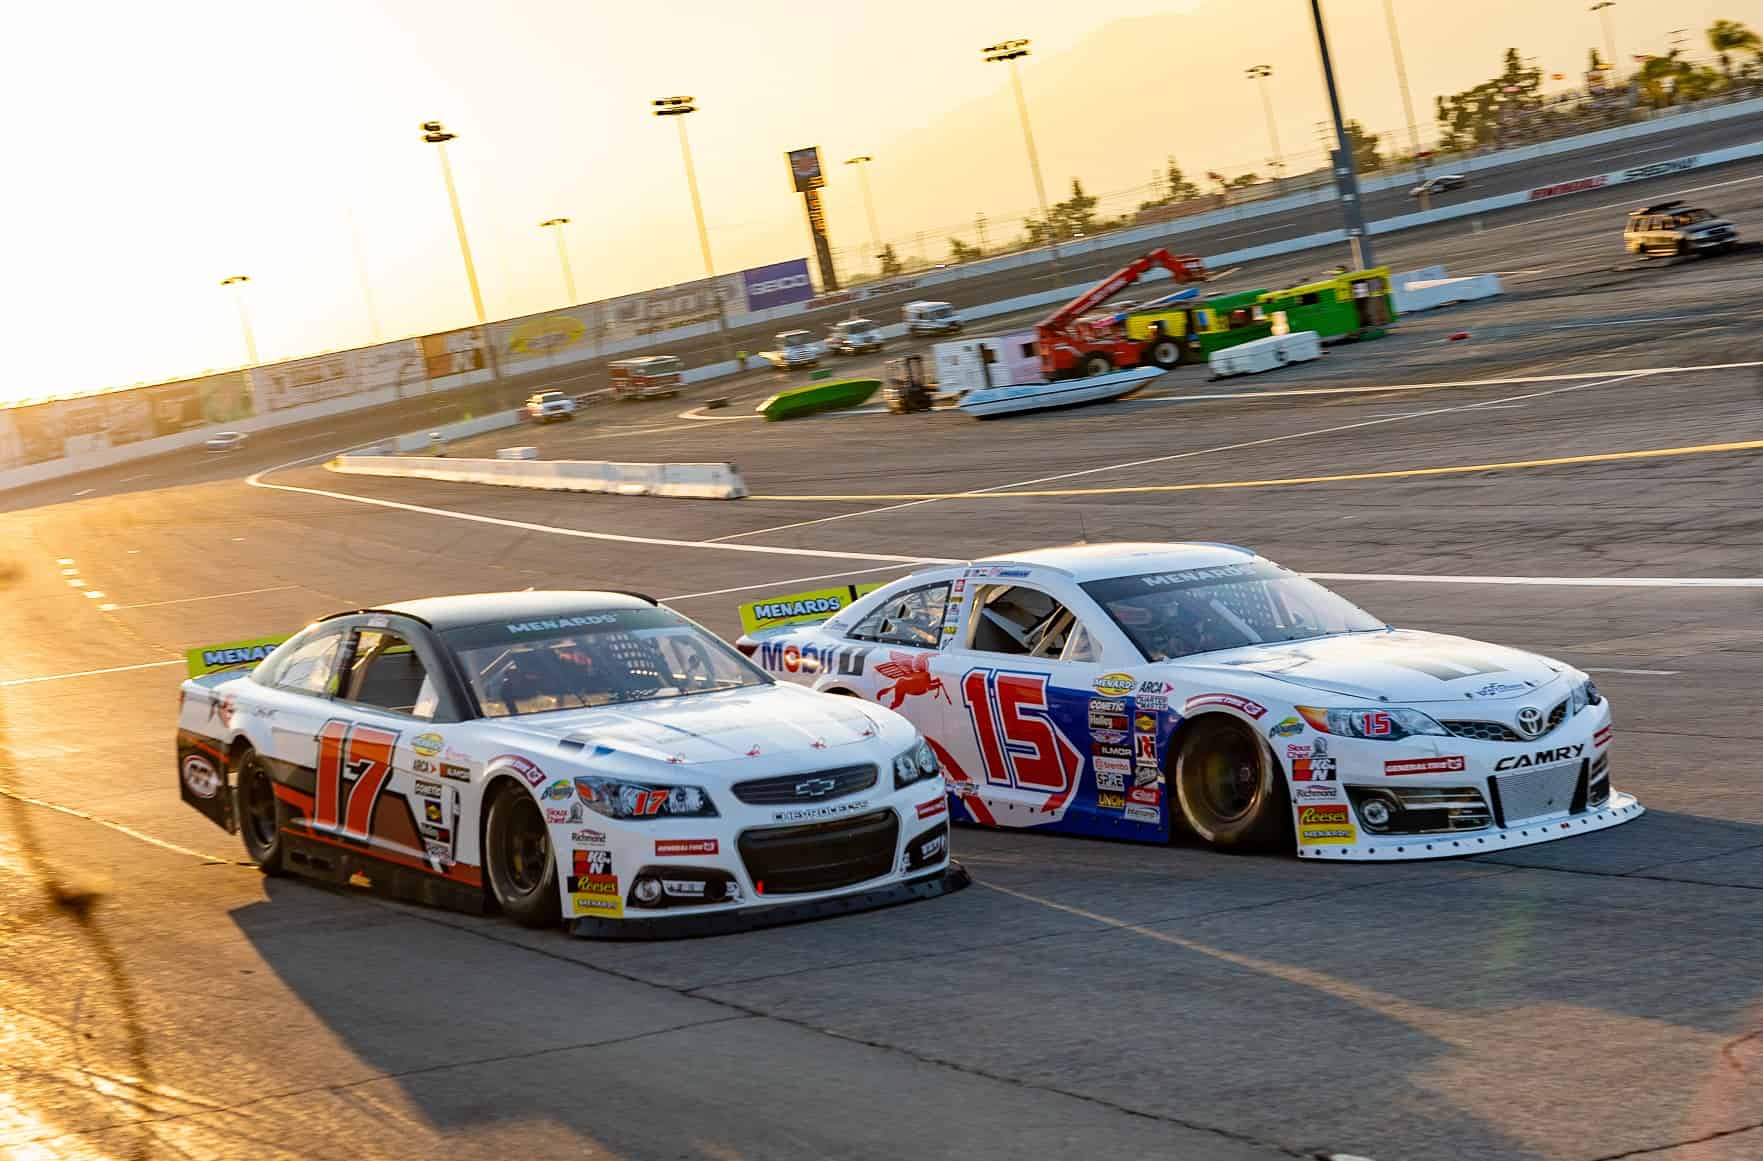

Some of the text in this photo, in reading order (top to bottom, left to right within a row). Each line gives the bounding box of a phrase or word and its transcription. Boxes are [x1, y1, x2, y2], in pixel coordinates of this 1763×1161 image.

[749, 274, 809, 295] GEICO
[753, 597, 841, 620] MENARDS
[507, 614, 617, 633] MENARDS
[1092, 678, 1137, 689] MENARDS
[1139, 680, 1164, 693] ARCA
[960, 667, 1068, 793] 15
[1363, 713, 1391, 735] 15
[1102, 747, 1132, 757] ILMOR
[1494, 743, 1585, 772] CAMRY
[312, 718, 402, 843] 17
[632, 789, 670, 816] 17
